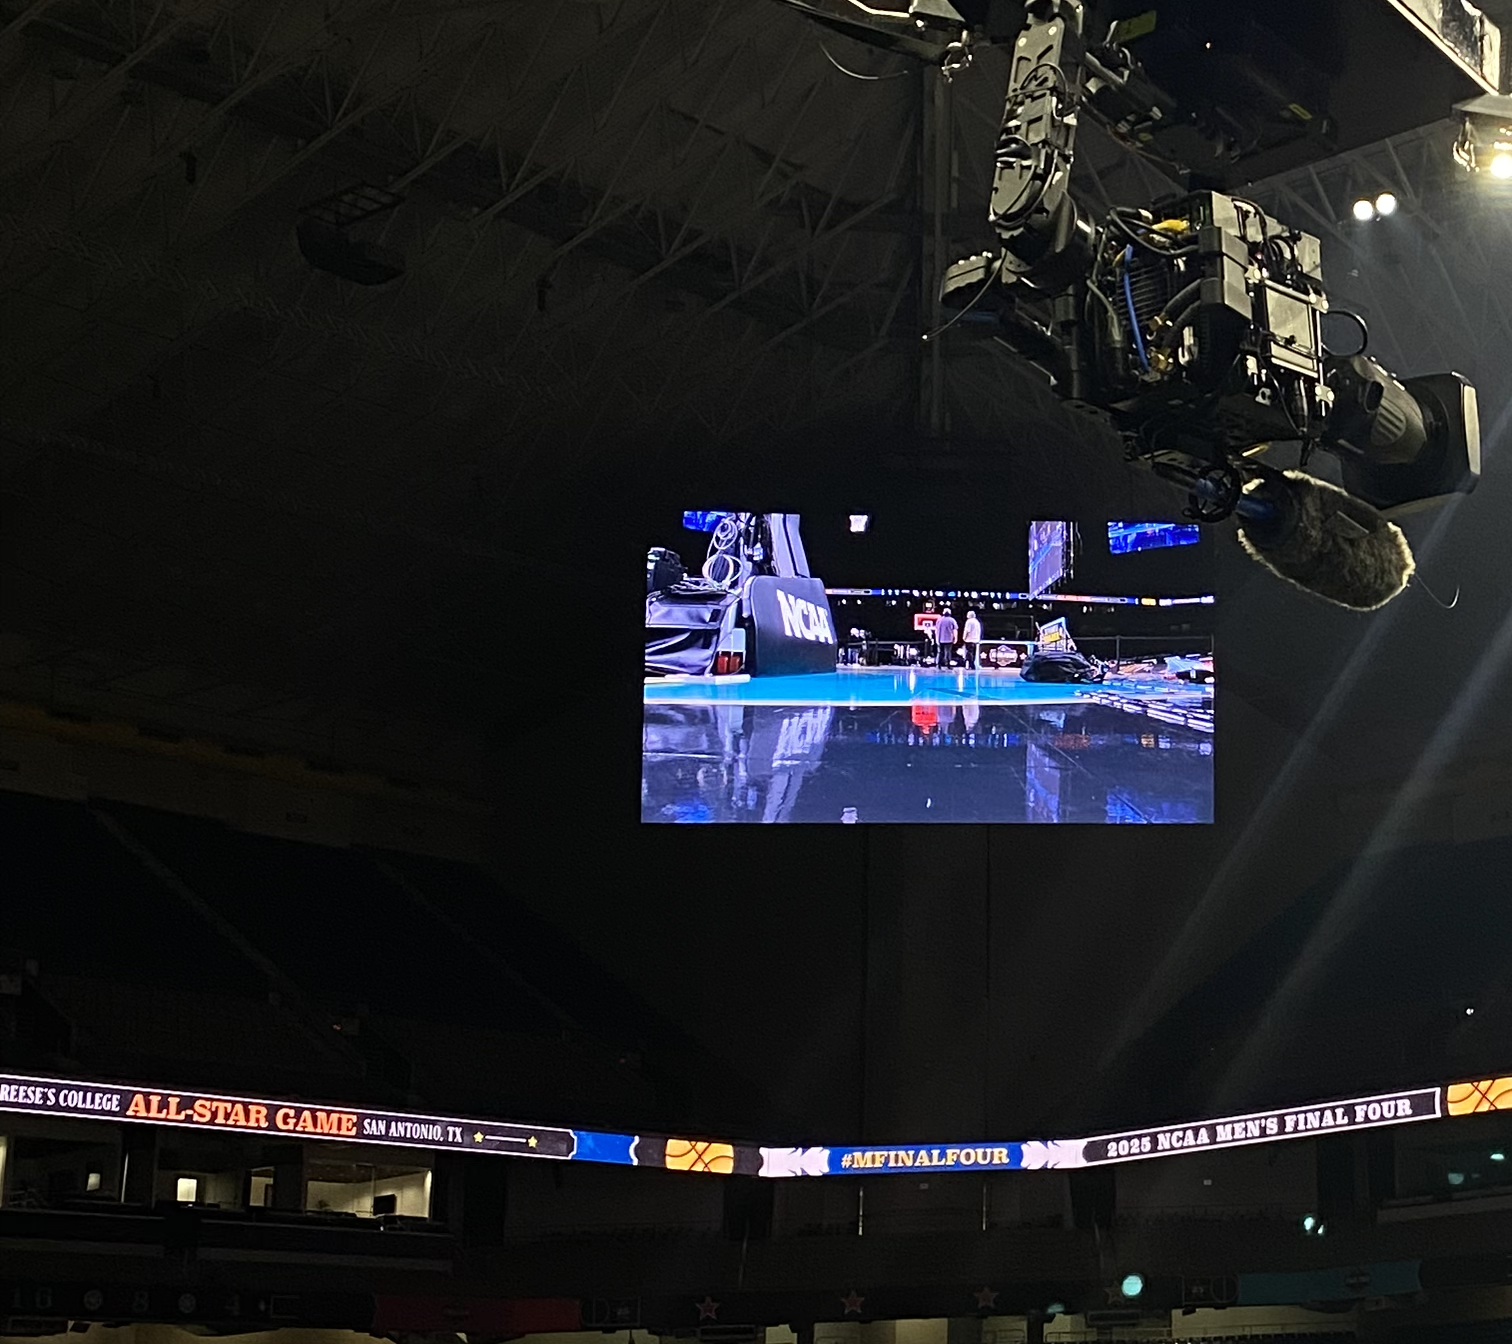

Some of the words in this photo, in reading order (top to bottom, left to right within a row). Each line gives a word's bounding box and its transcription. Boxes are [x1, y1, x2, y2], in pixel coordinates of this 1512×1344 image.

[776, 589, 834, 645] NCAA
[0, 1083, 56, 1107] REESE'S
[59, 1088, 121, 1112] COLLEGE
[126, 1093, 269, 1128] ALL-STAR
[275, 1107, 358, 1136] GAME
[363, 1118, 387, 1136] SAN
[446, 1126, 463, 1143] TX
[1106, 1136, 1151, 1158] 2025
[1157, 1126, 1211, 1150] NCAA
[1216, 1117, 1278, 1144] MEN'S
[1284, 1108, 1349, 1135] FINAL
[1354, 1099, 1413, 1124] FOUR
[840, 1146, 1010, 1170] #MFINALFOUR
